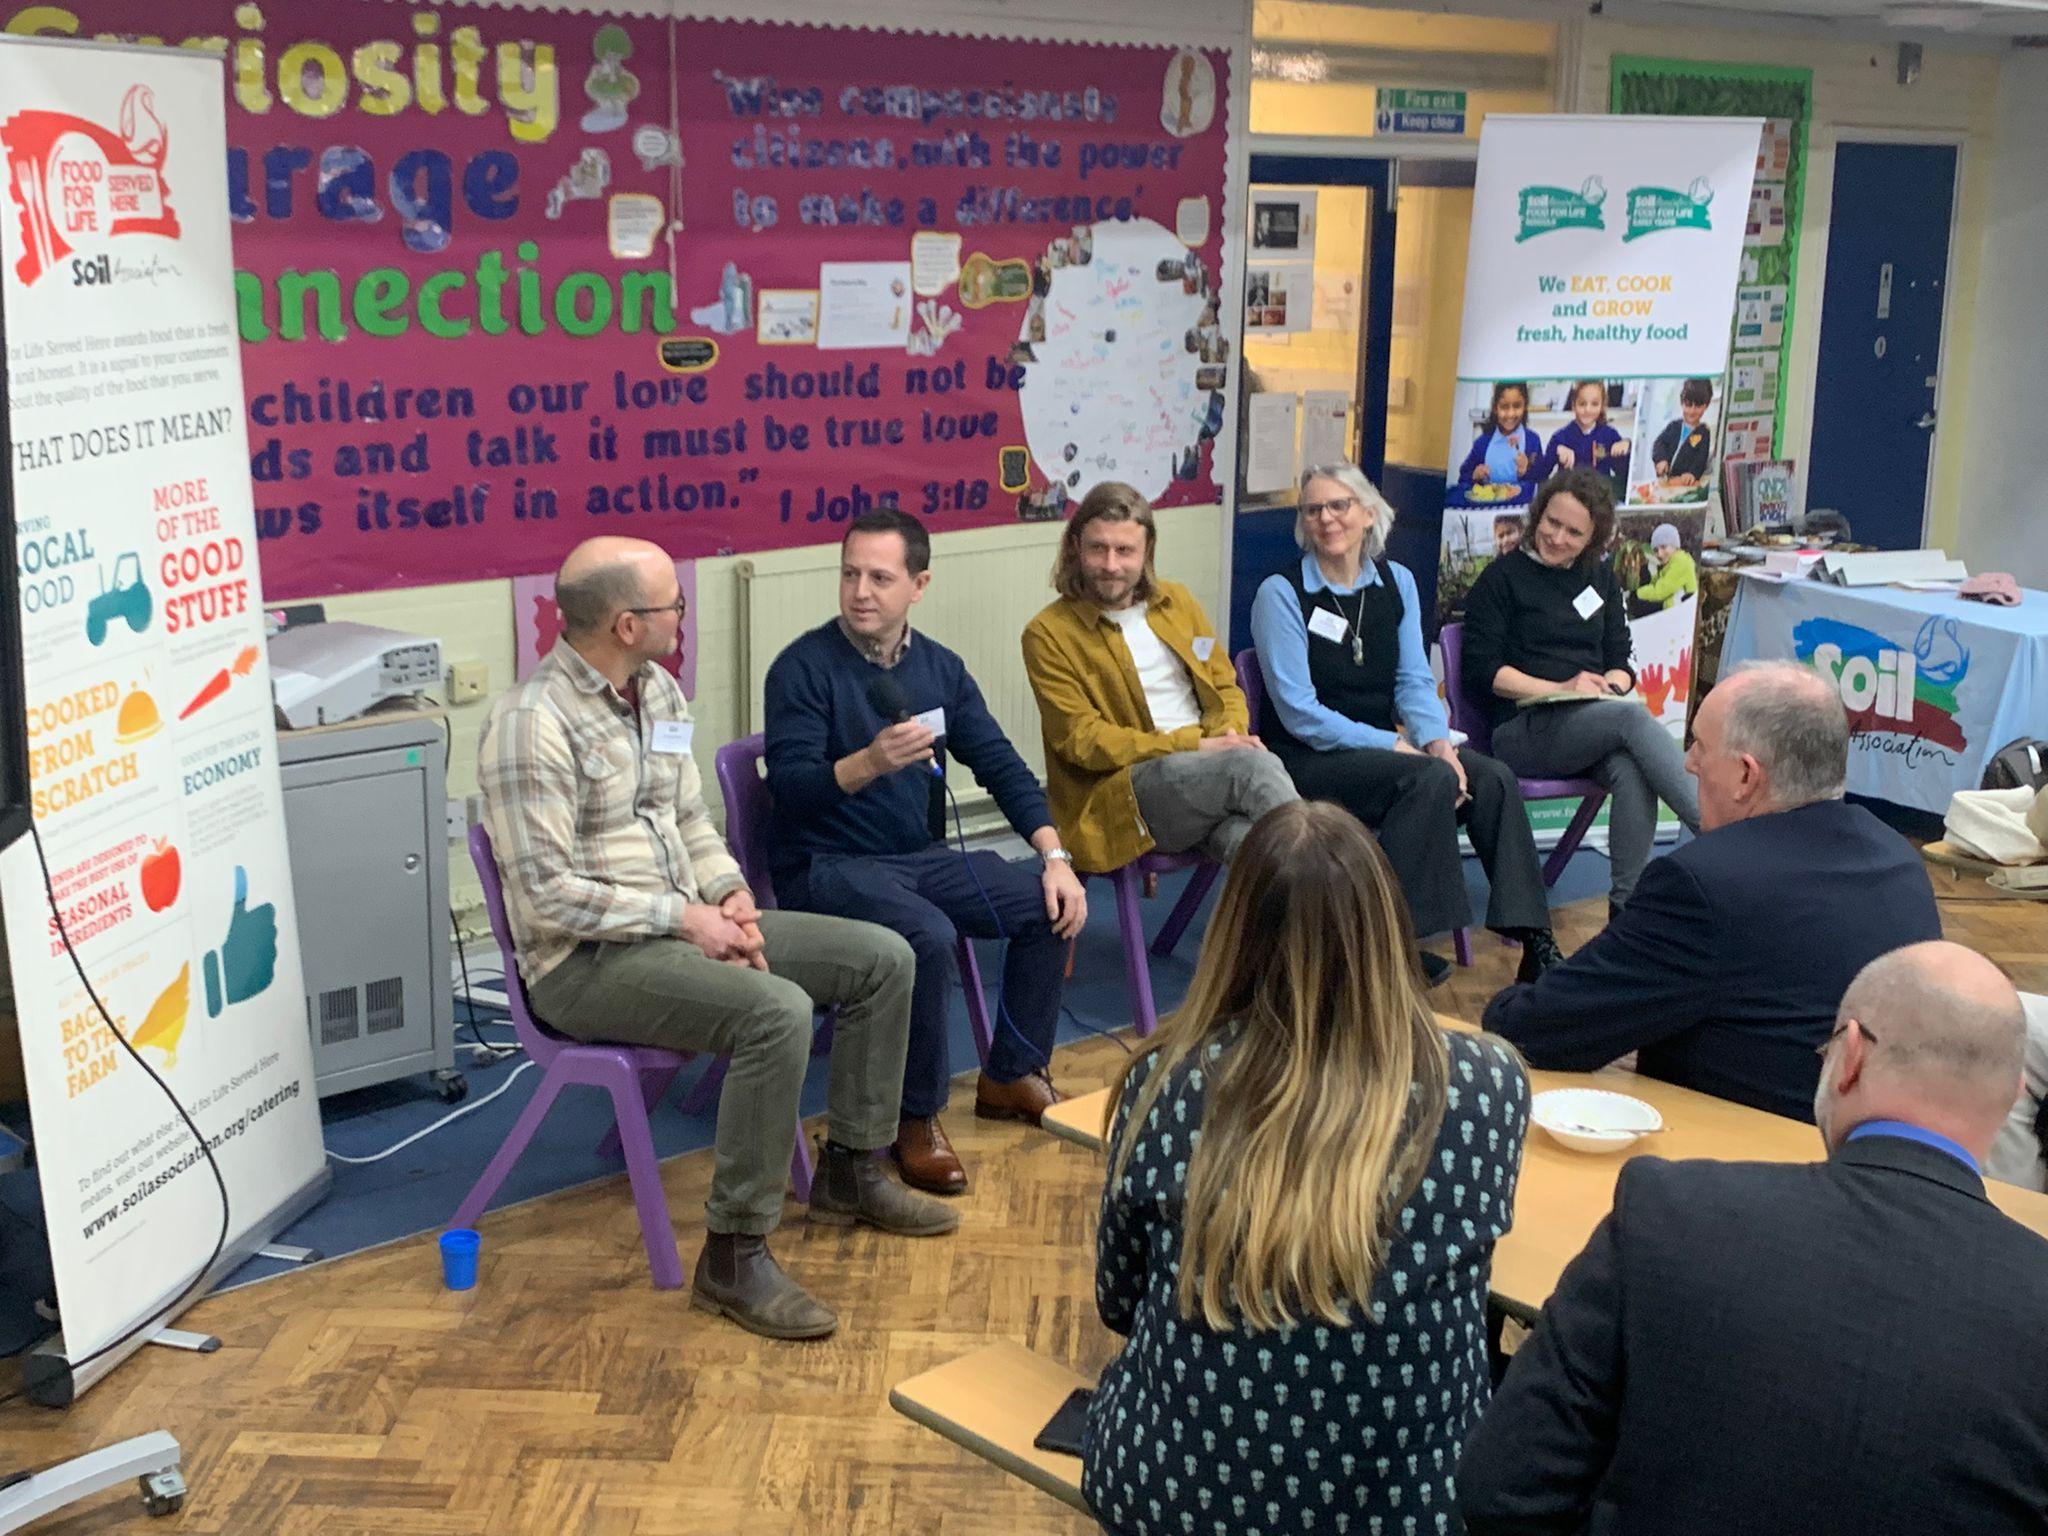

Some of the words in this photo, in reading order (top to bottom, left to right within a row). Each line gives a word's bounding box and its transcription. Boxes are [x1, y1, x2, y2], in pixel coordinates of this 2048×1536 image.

[185, 2, 560, 143] iosity
[1402, 113, 1430, 131] Keep
[1430, 115, 1456, 130] clear
[1404, 91, 1431, 108] Fire
[1432, 93, 1456, 109] exit
[61, 160, 103, 184] FOOD
[911, 128, 991, 169] with
[1003, 130, 1062, 169] the
[1078, 138, 1185, 180] power
[63, 185, 96, 209] FOR
[107, 173, 154, 193] SERVED
[109, 194, 140, 212] HERE
[66, 210, 99, 233] LIFE
[799, 186, 904, 227] make
[917, 196, 938, 225] a
[1538, 275, 1566, 294] We
[1570, 275, 1611, 294] EAT,
[1616, 275, 1673, 293] COOK
[1552, 299, 1588, 318] and
[1592, 299, 1654, 318] GROW
[1516, 324, 1568, 343] fresh,
[1572, 323, 1643, 345] healthy
[1646, 323, 1690, 341] food
[251, 375, 476, 427] children
[508, 381, 590, 416] our
[614, 370, 708, 411] love
[744, 360, 881, 402] should
[905, 357, 966, 396] not
[985, 355, 1027, 393] be
[13, 434, 64, 471] HAT
[69, 423, 131, 462] DOES
[135, 418, 156, 450] IT
[161, 406, 233, 445] MEAN?
[251, 437, 315, 482] ds
[333, 431, 431, 479] and
[466, 423, 560, 469] talk
[588, 416, 619, 463] it
[643, 417, 748, 461] must
[763, 414, 811, 451] be
[825, 415, 905, 450] true
[921, 408, 1000, 444] love
[153, 477, 209, 513] MORE
[256, 501, 322, 541] ws
[355, 481, 491, 532] itself
[513, 477, 559, 521] in
[920, 477, 991, 516] 3:18
[156, 515, 180, 543] OF
[182, 506, 221, 537] THE
[21, 527, 95, 575] OCAL
[161, 536, 244, 588] GOOD
[24, 574, 75, 614] OOD
[164, 578, 249, 634] STUFF
[27, 680, 120, 738] COOKED
[29, 728, 96, 780] FROM
[183, 746, 262, 796] ECONOMY
[31, 751, 140, 821] SCRATCH
[48, 880, 130, 937] SEASONAL
[63, 1038, 89, 1070] TO
[66, 1048, 118, 1100] FARM
